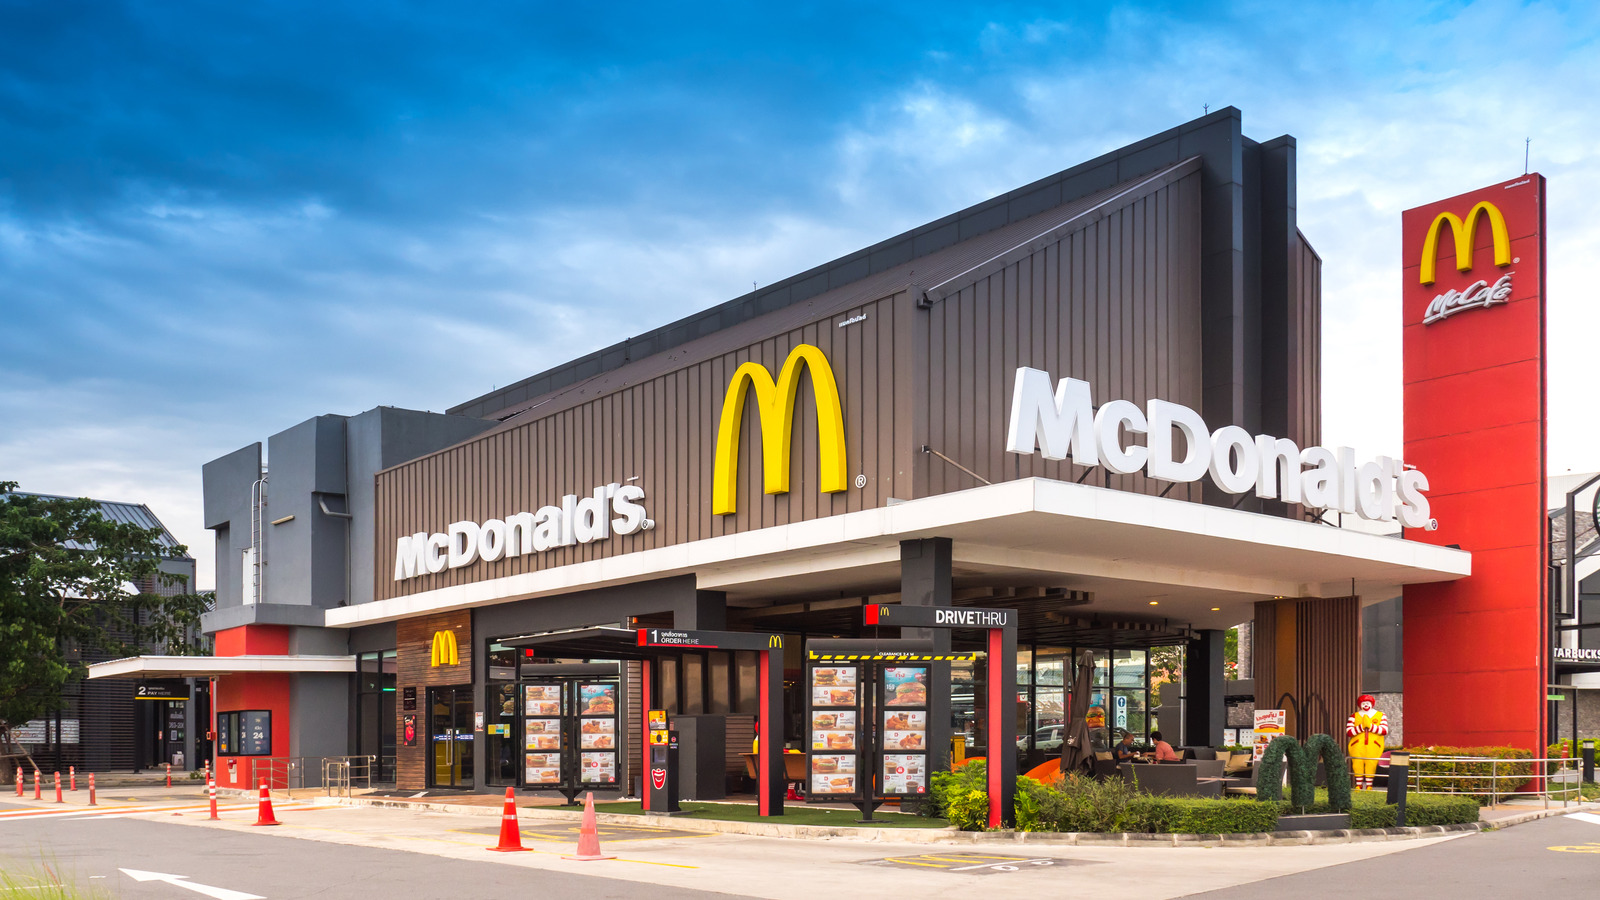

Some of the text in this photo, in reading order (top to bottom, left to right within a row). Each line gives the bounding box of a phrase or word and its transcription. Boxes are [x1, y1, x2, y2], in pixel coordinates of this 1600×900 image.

[1006, 366, 1431, 529] McDonald's
[394, 482, 647, 581] McDonald's
[651, 629, 658, 643] 1
[138, 686, 147, 696] 2
[252, 731, 264, 739] 24
